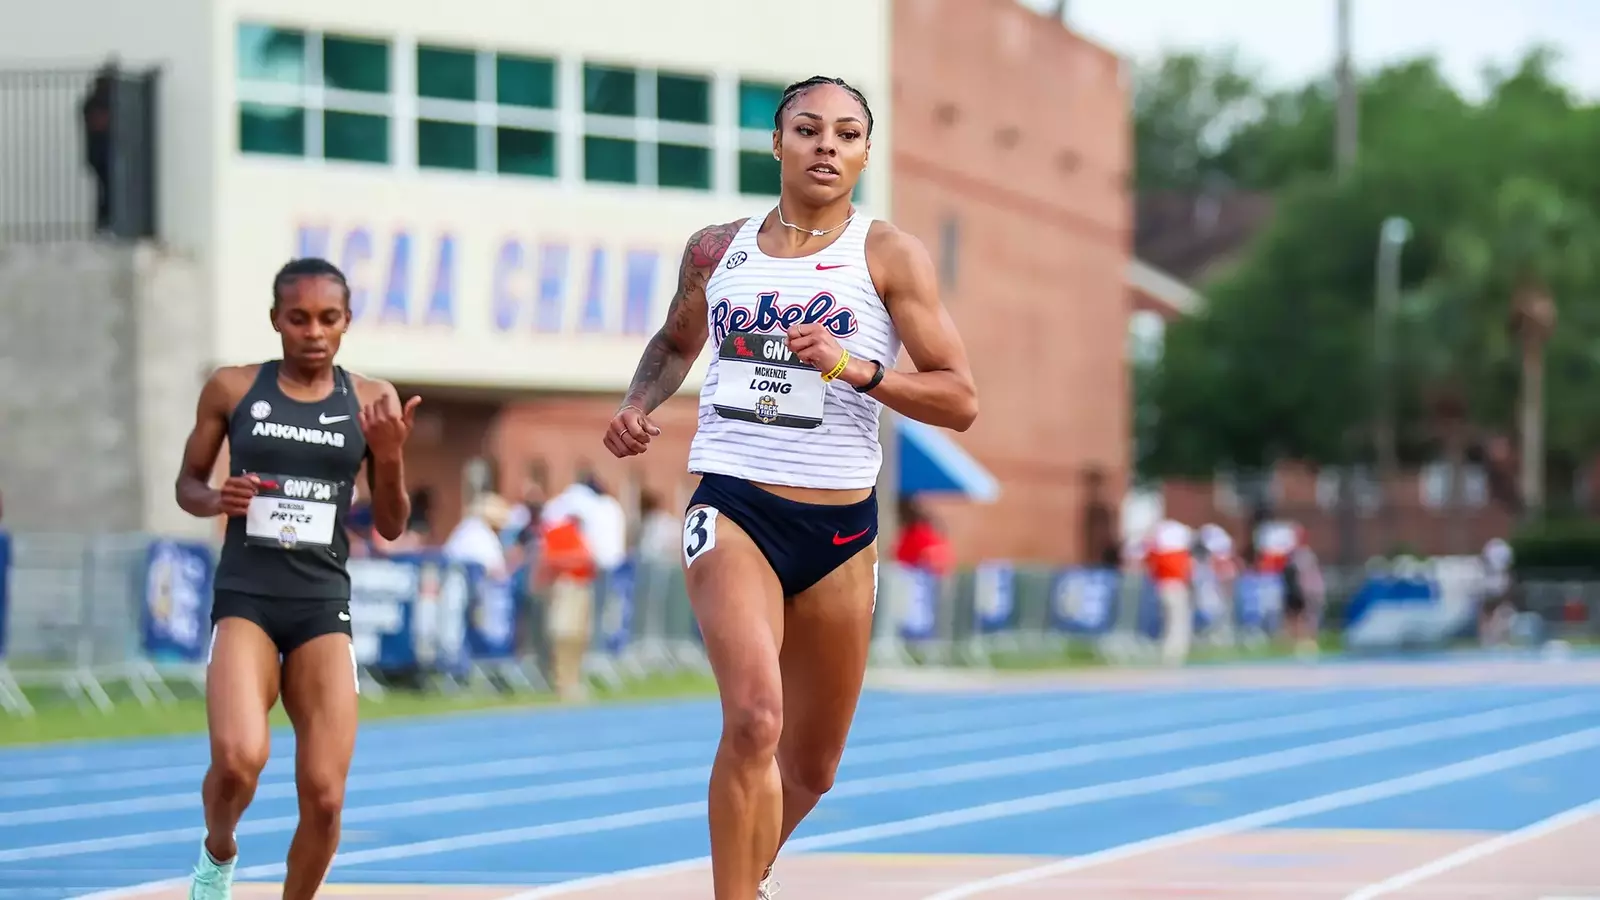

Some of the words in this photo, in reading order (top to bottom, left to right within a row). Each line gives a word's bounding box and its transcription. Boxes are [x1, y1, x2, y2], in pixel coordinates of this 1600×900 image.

[726, 251, 747, 269] SEC
[711, 291, 859, 348] Rebels
[754, 366, 788, 380] MCKENZIE
[749, 378, 793, 394] LONG
[756, 403, 777, 412] TRACK
[251, 421, 346, 448] ARKANSAS
[284, 479, 313, 498] GNV
[313, 482, 331, 501] '24
[270, 510, 313, 524] PRYCE
[686, 509, 708, 558] 3
